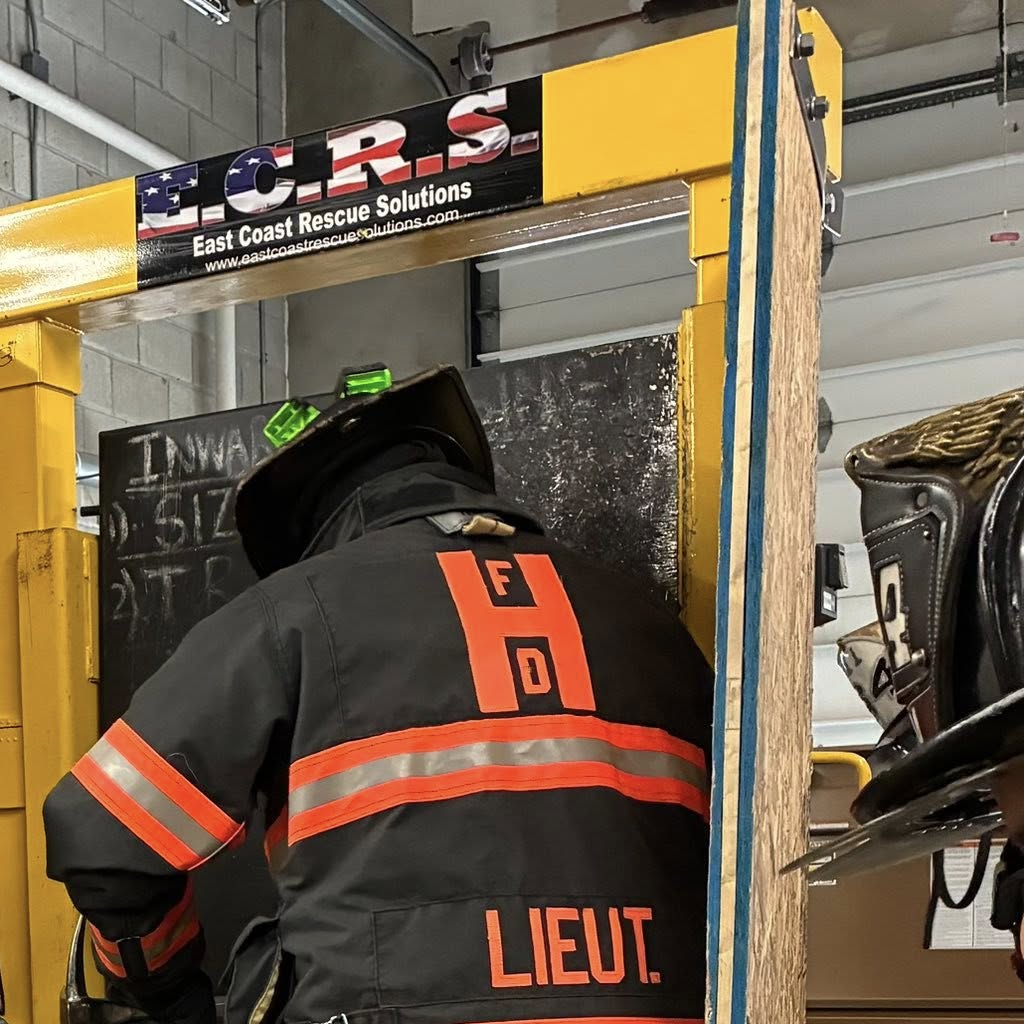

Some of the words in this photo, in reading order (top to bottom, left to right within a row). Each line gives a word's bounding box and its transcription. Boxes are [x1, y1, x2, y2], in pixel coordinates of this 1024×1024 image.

[136, 87, 540, 239] E.C.R.S.
[193, 229, 233, 257] East
[238, 216, 293, 247] Coast
[298, 203, 370, 234] Rescue
[376, 181, 472, 217] Solutions
[205, 208, 460, 272] www.eastcoastrescuesolutions.com
[486, 906, 661, 988] LIEUT.
